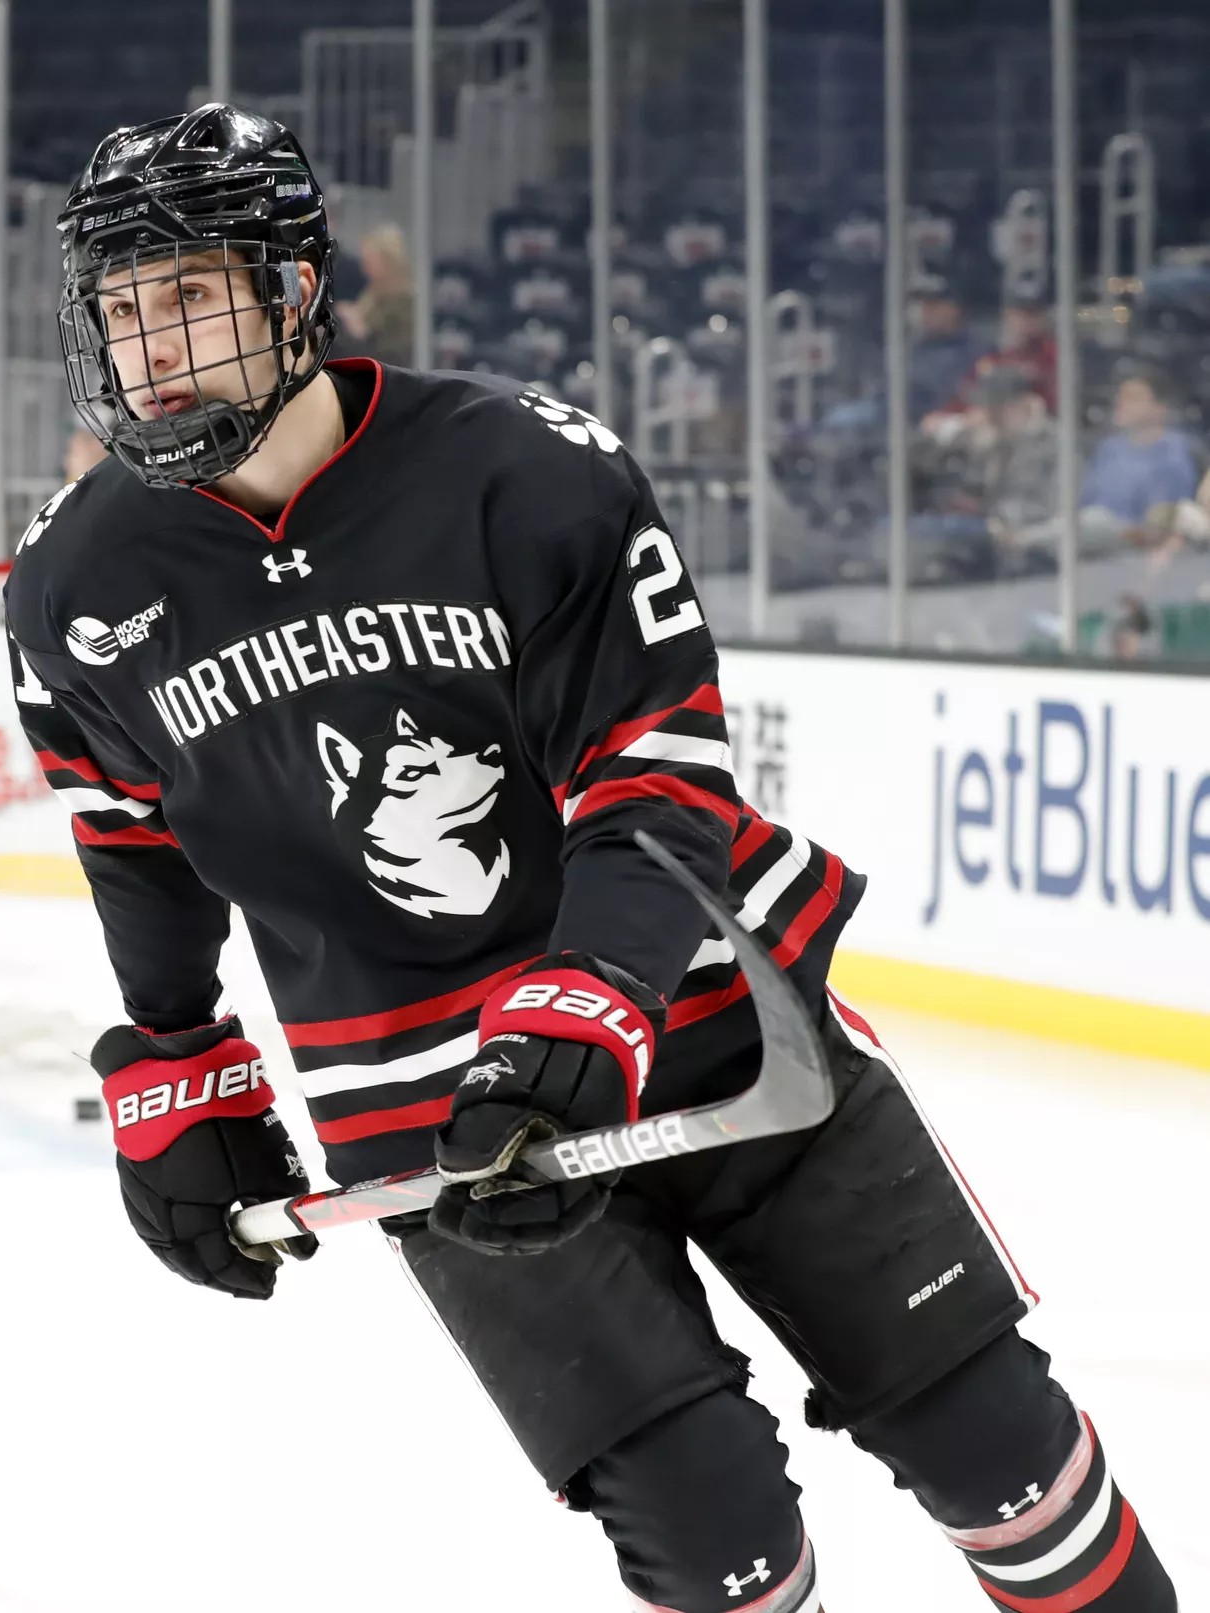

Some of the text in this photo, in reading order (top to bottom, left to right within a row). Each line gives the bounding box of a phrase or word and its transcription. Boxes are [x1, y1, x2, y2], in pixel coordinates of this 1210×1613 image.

[81, 202, 150, 232] BAUER
[113, 602, 165, 639] HOCKEY
[118, 623, 150, 649] EAST
[148, 603, 511, 747] NORTHEASTERN
[116, 1058, 270, 1129] BAUER
[554, 1114, 696, 1180] BAUER
[908, 1262, 965, 1310] BAUER
